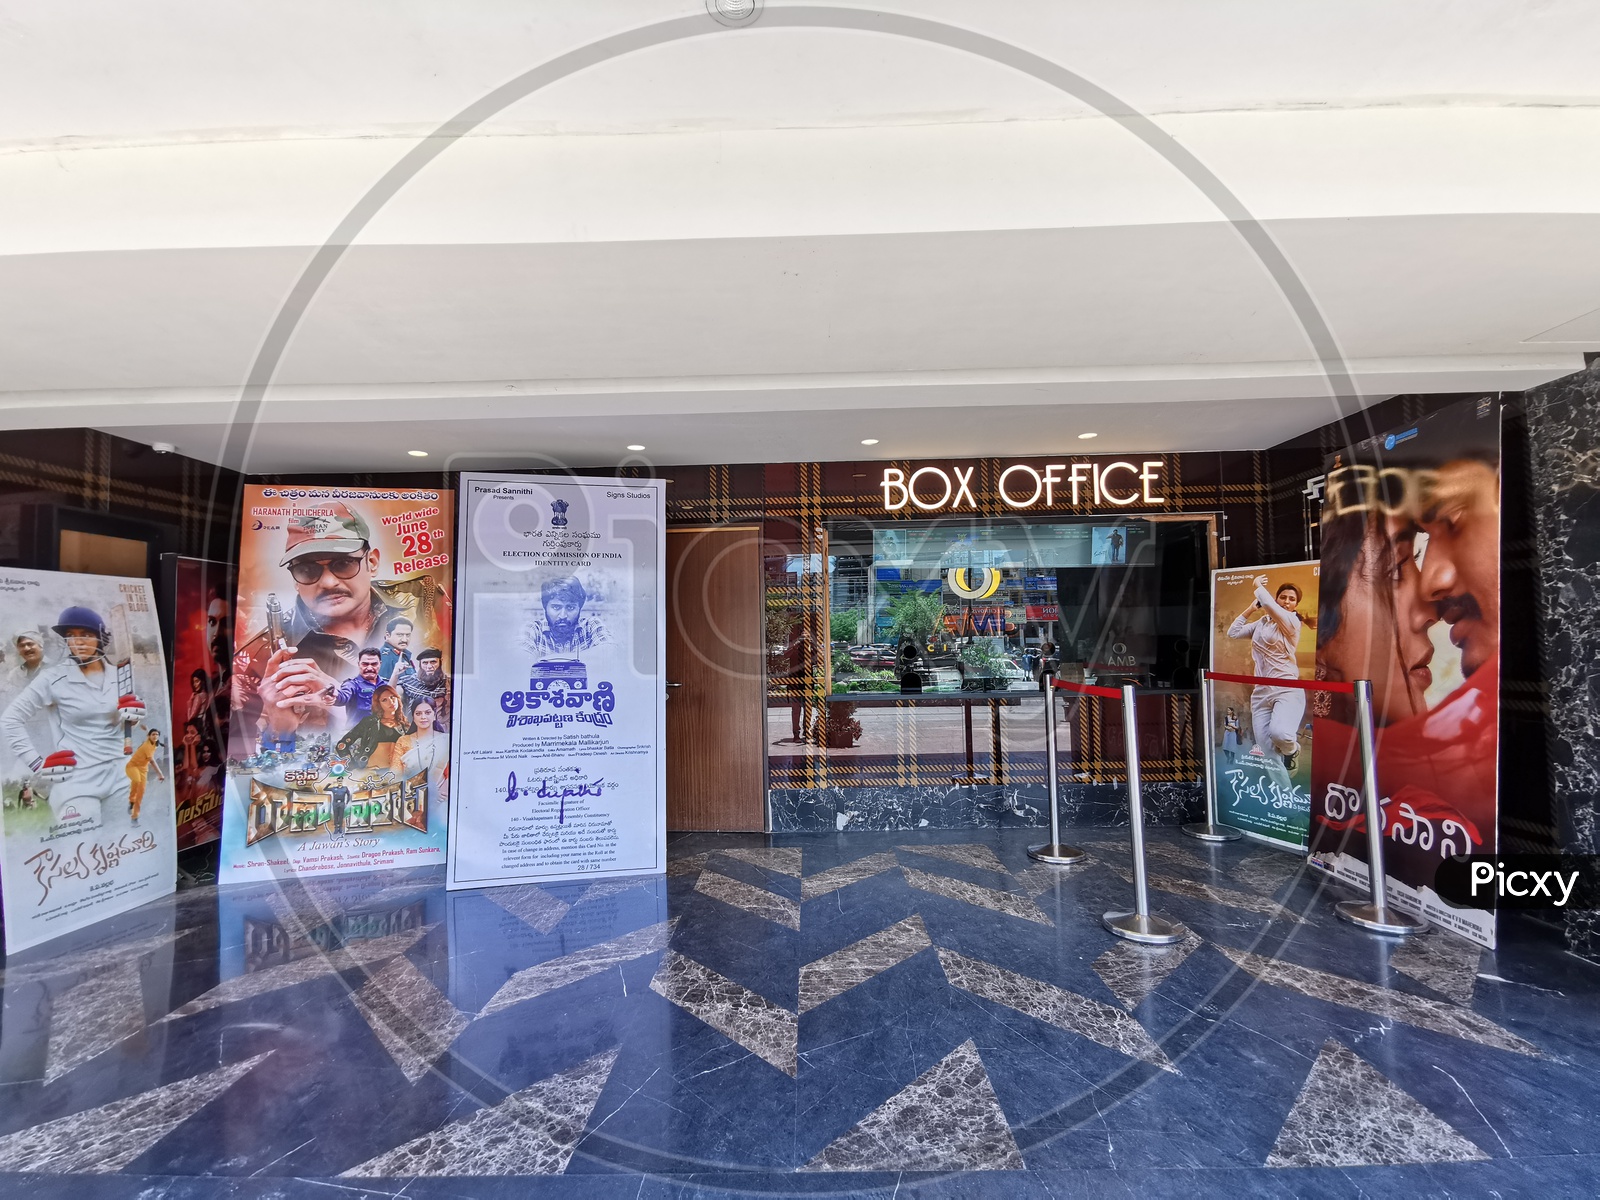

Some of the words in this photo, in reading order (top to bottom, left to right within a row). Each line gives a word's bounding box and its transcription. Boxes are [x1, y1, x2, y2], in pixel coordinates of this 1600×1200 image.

[880, 466, 977, 510] BOX
[998, 461, 1165, 507] OFFICE
[263, 488, 277, 497] ఈ
[278, 489, 306, 500] చిత్రం
[308, 491, 330, 499] మన
[332, 489, 399, 500] వీరజవానులకు
[402, 491, 439, 500] అంకితం
[502, 488, 532, 496] Sannithi
[606, 491, 624, 499] Signs
[252, 508, 290, 516] HARANATH
[292, 508, 334, 517] POLICHERLA
[382, 512, 413, 526] World
[414, 506, 439, 519] wide
[396, 519, 428, 536] June
[523, 530, 542, 538] భారత
[546, 530, 570, 541] ఎన్నికల
[402, 532, 432, 558] 28
[434, 529, 444, 539] th
[394, 552, 449, 576] Release
[119, 584, 146, 594] CRICKET
[126, 594, 134, 602] IN
[136, 595, 147, 603] THE
[128, 603, 149, 612] BLOOD
[1108, 656, 1136, 666] AMB
[500, 681, 616, 714] ఆకాశవాణి
[576, 711, 613, 728] కేంద్రం
[298, 842, 306, 852] A
[309, 839, 350, 852] Jawan's
[352, 837, 380, 849] Story
[361, 850, 381, 859] Dragon
[406, 848, 418, 856] Ram
[298, 863, 336, 872] Chandrabose,
[24, 842, 90, 906] కౌసల్య
